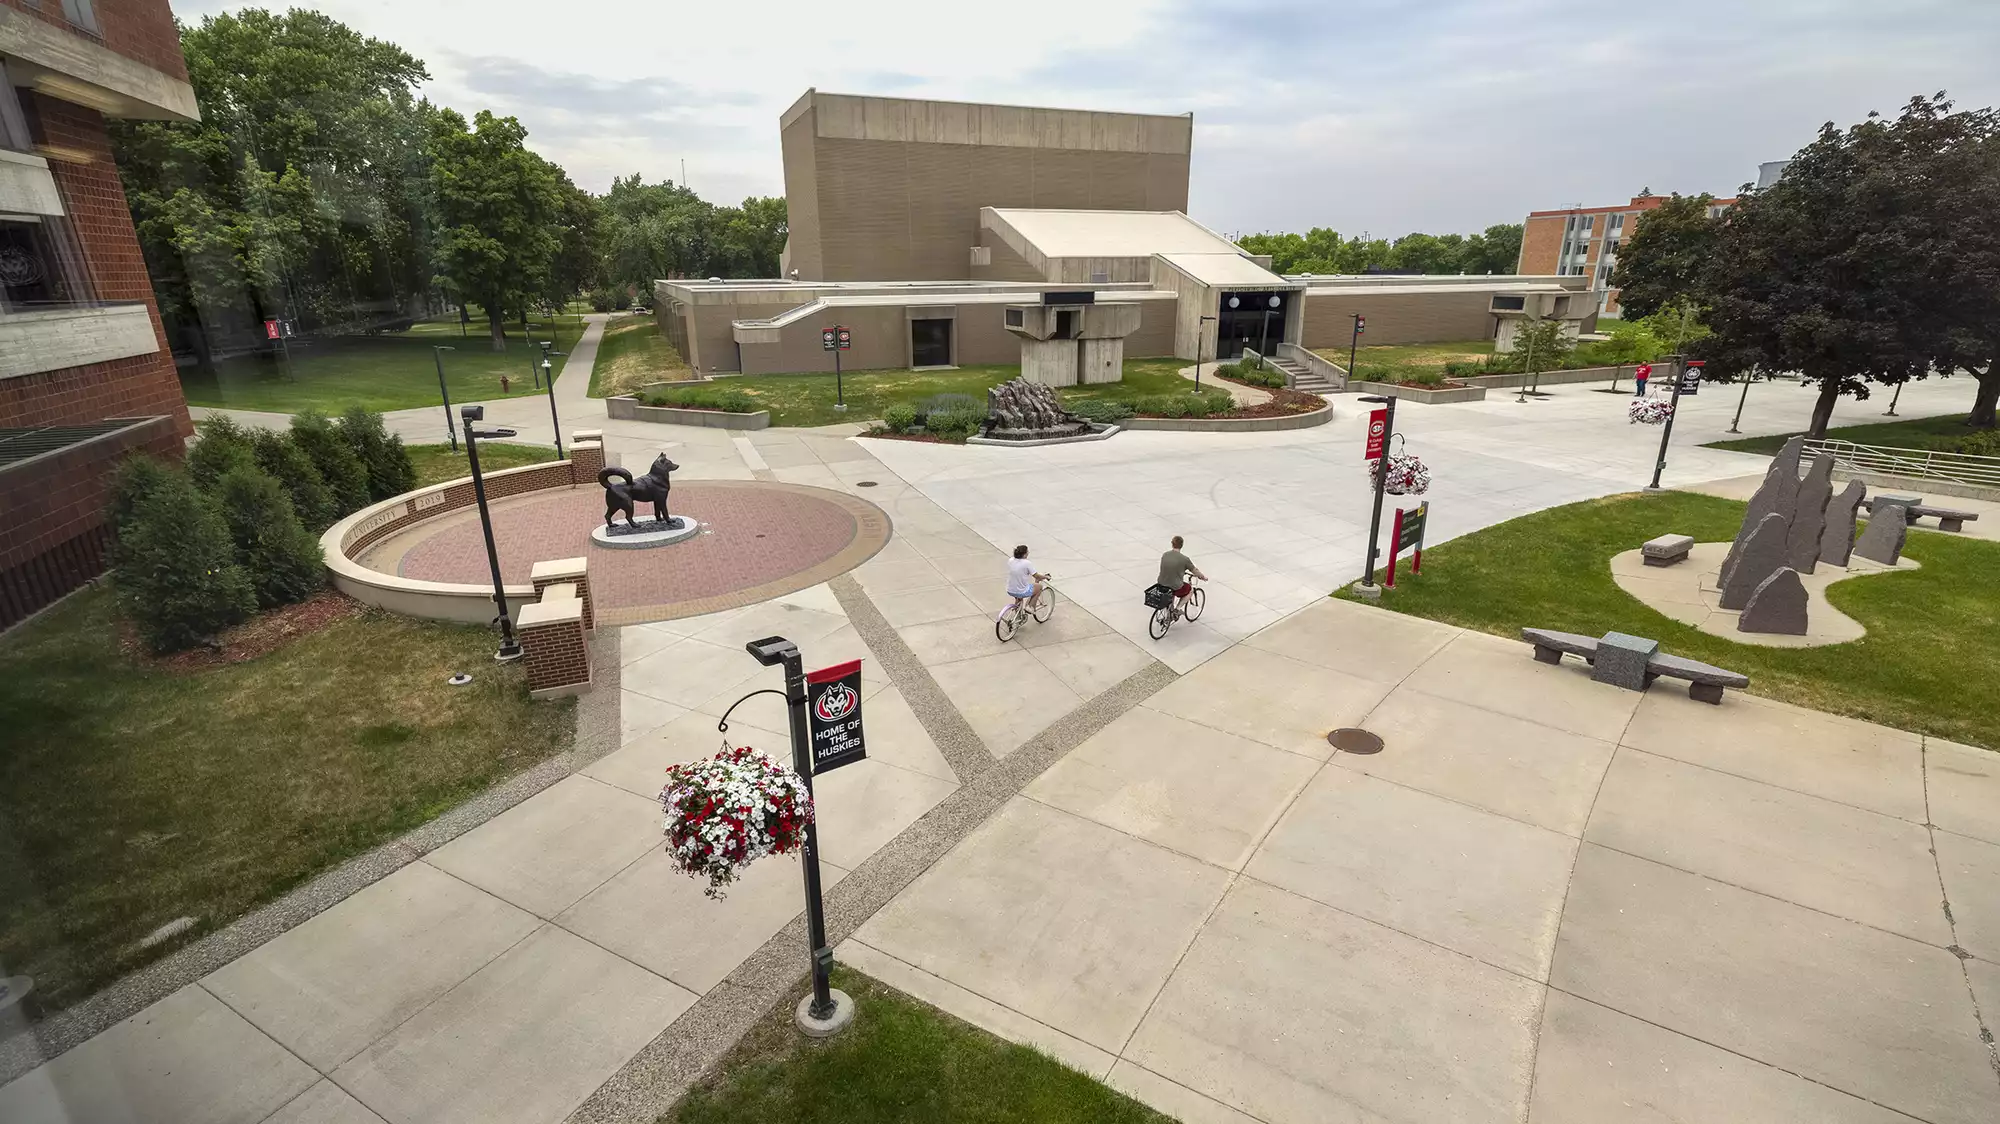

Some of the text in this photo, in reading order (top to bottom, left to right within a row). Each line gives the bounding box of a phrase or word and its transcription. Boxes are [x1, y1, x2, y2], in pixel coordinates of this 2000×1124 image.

[420, 494, 441, 508] 2019
[352, 509, 397, 538] UNIVERSITY
[816, 719, 860, 741] HOME OF
[829, 732, 848, 746] THE
[818, 737, 861, 759] HUSKIES
